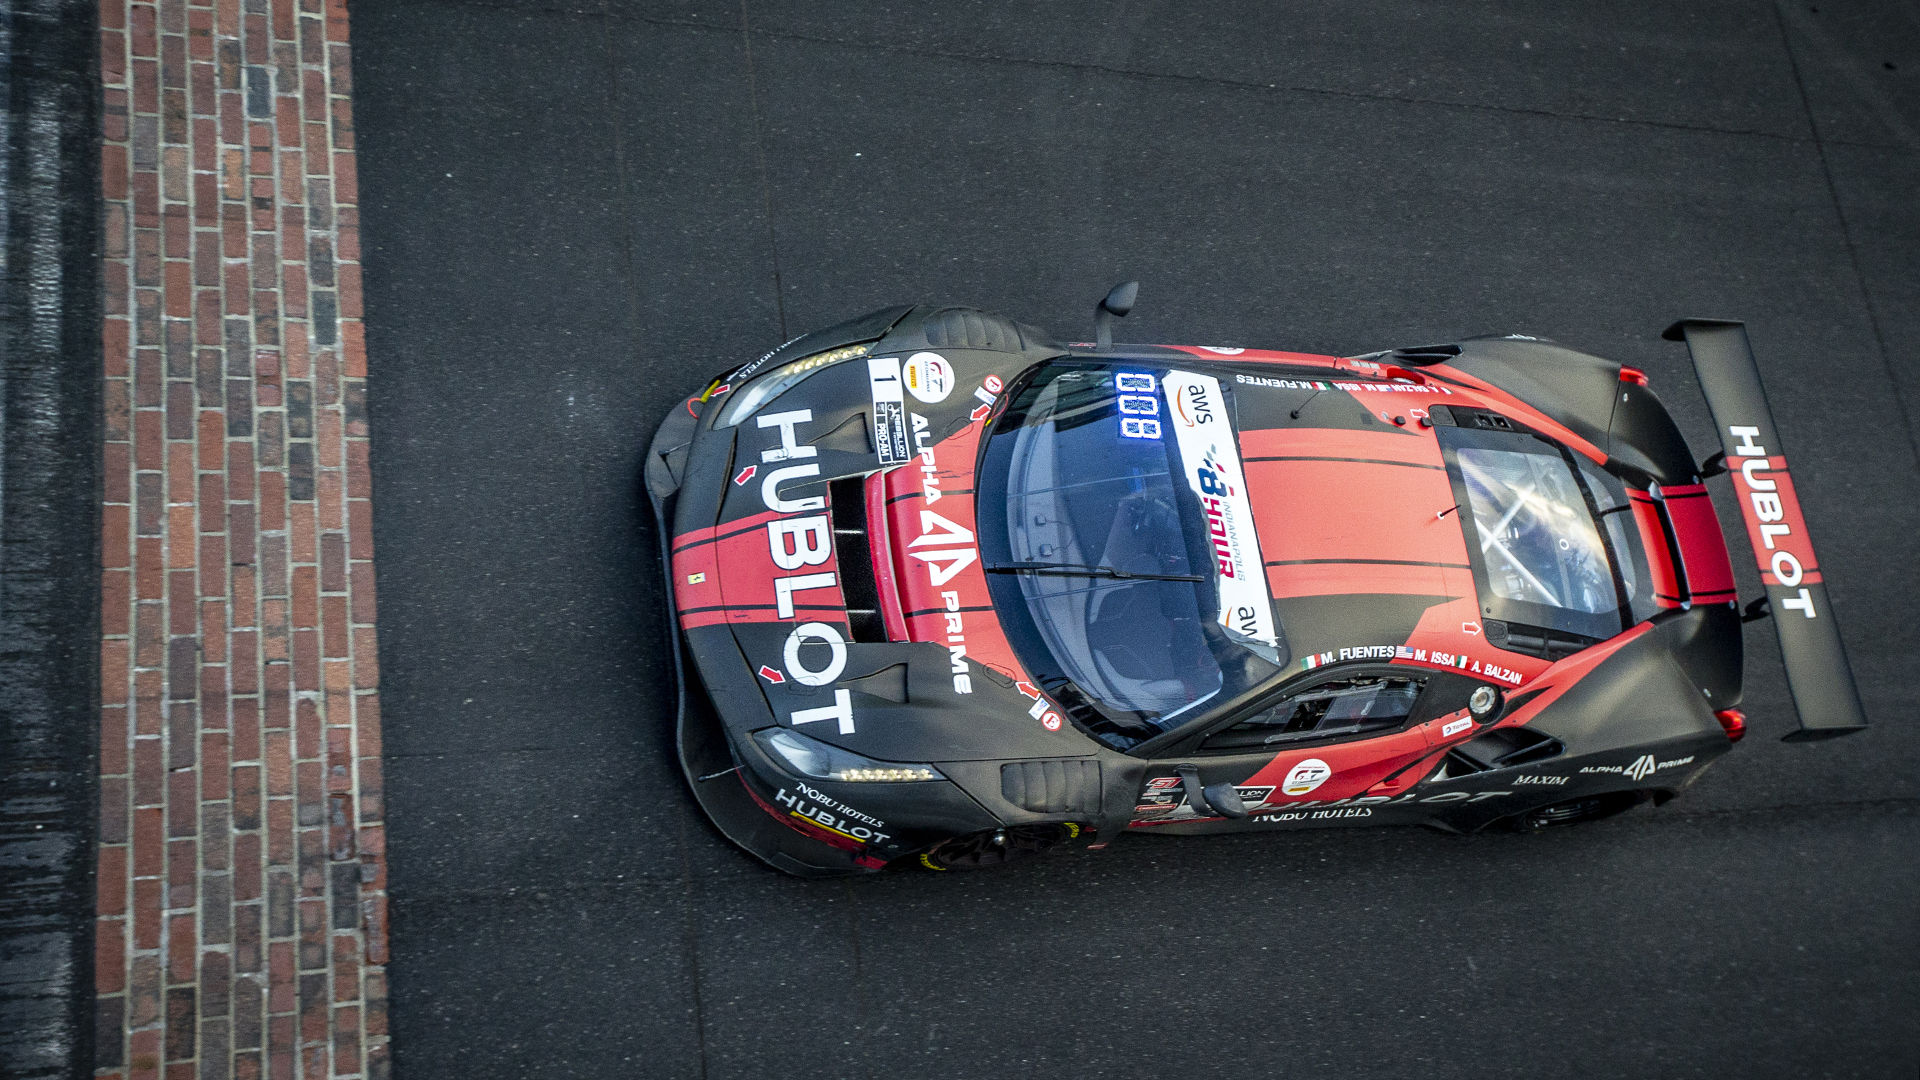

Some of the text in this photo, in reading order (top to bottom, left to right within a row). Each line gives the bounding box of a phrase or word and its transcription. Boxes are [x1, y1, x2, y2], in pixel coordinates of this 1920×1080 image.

[874, 374, 897, 382] 1
[1188, 385, 1213, 425] aws
[877, 423, 890, 457] PRO-AM
[1197, 467, 1228, 498] 8
[1729, 425, 1817, 619] HUBLOT
[757, 408, 856, 735] HUBLOT
[910, 412, 972, 695] ALPHA PRIME
[1238, 606, 1258, 637] aw
[1320, 645, 1523, 685] M. FUENTES M. ISSA A. BALZAN
[1511, 774, 1570, 786] MAXIM
[1579, 755, 1695, 774] ALPHA PRIME
[775, 788, 891, 843] HUBLOT
[795, 781, 885, 828] NOBU HOTELS
